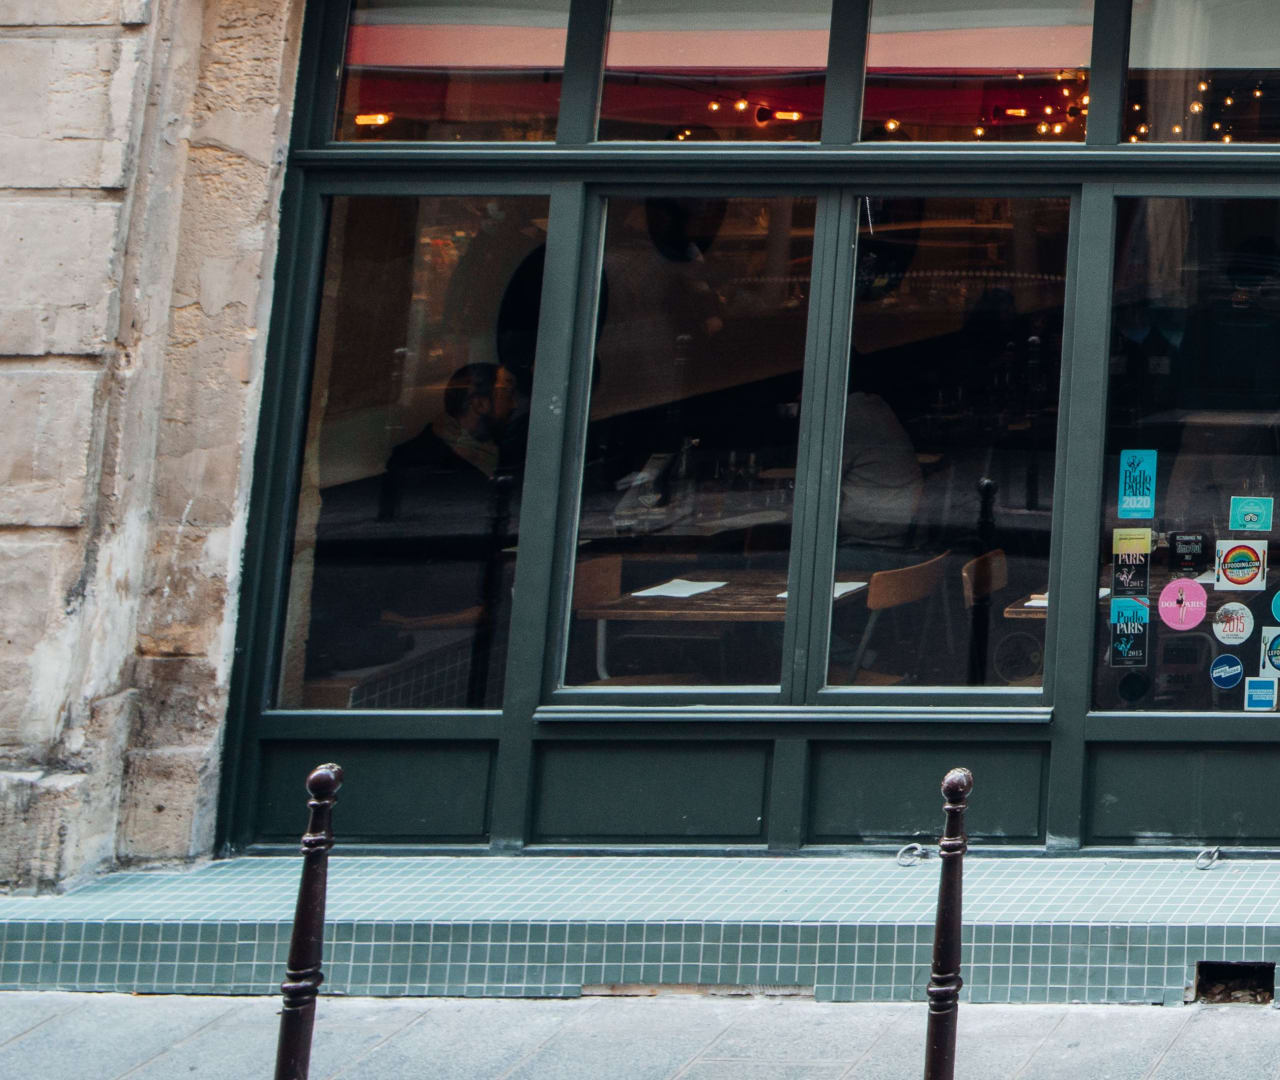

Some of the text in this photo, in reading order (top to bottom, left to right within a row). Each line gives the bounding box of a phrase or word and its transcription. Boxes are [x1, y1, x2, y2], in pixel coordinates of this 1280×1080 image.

[1123, 482, 1151, 497] PARIS
[1122, 496, 1151, 508] 2020
[1118, 552, 1145, 565] PARIS
[1117, 611, 1144, 623] Pudlo
[1116, 622, 1144, 634] PARIS
[1222, 615, 1245, 633] 2015
